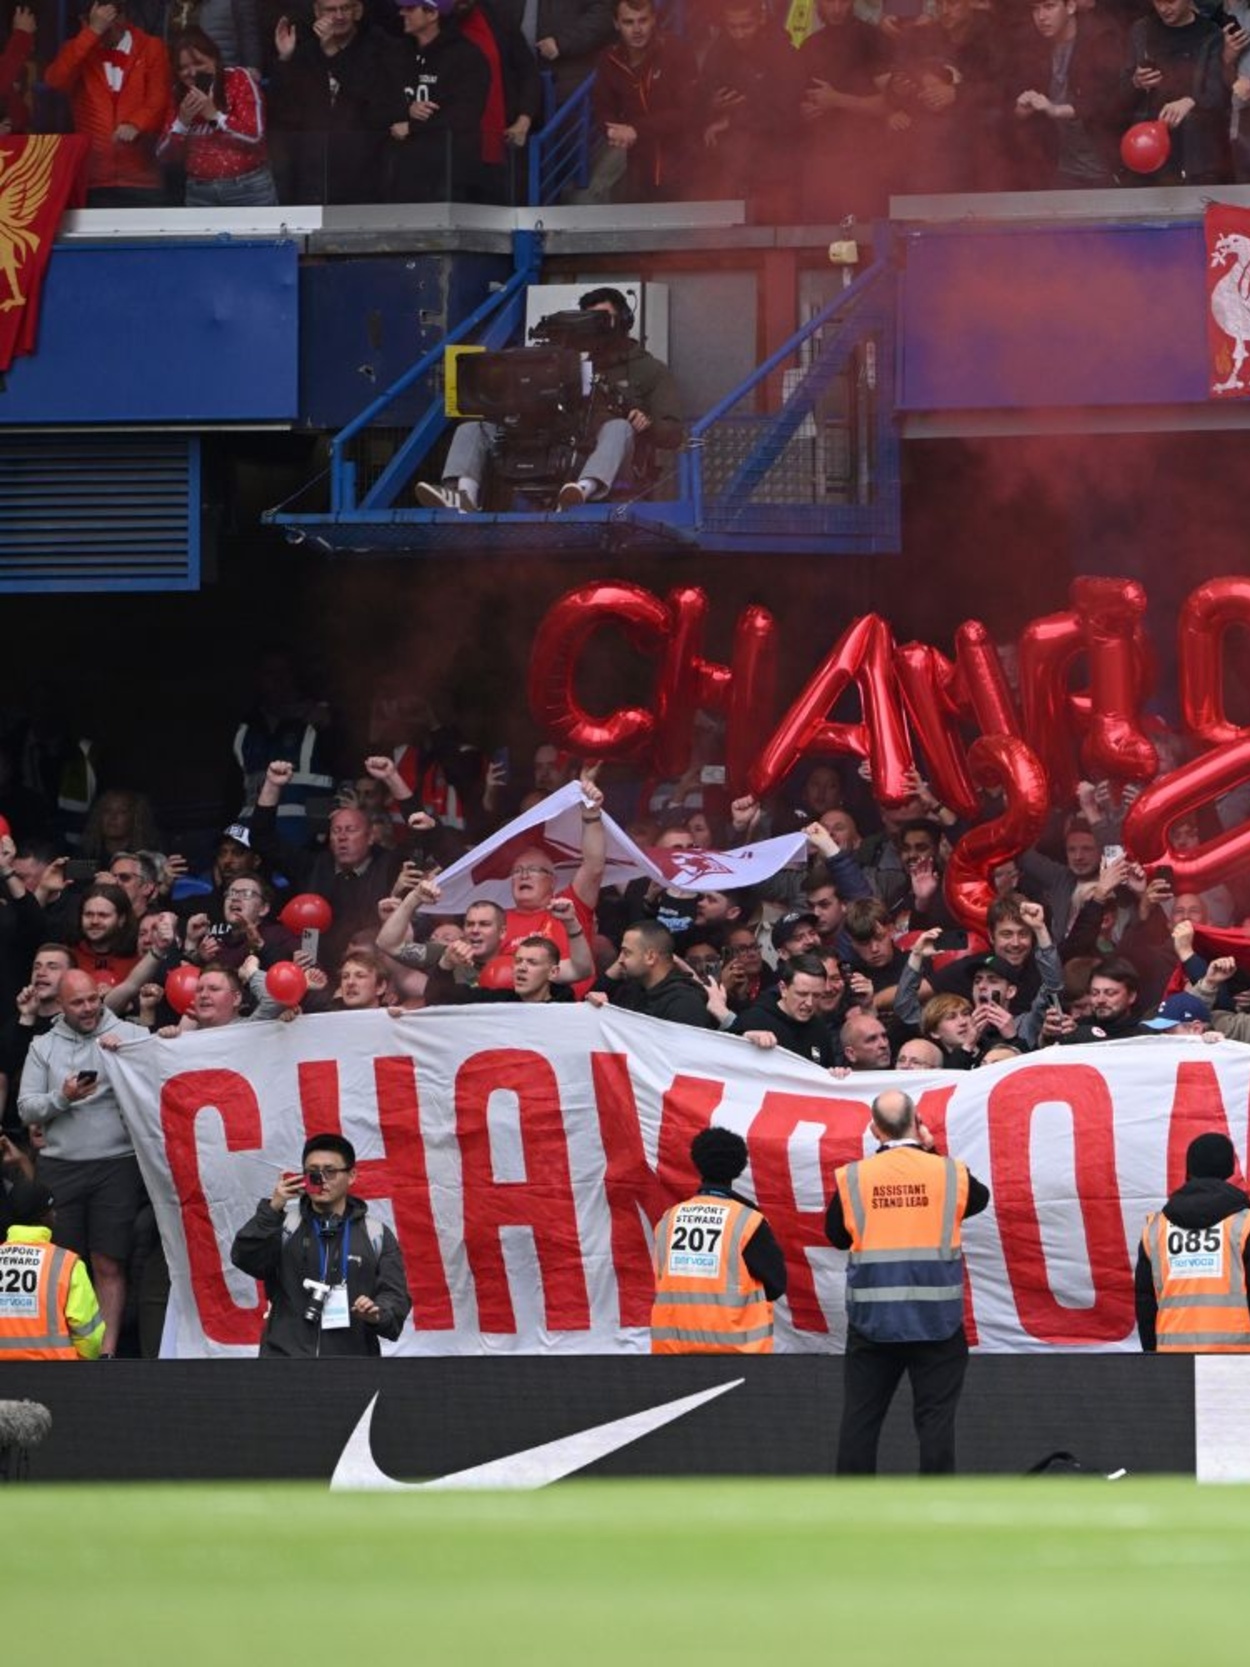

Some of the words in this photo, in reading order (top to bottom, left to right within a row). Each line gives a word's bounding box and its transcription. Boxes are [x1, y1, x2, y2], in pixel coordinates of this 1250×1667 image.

[873, 1184, 926, 1197] ASSISTANT
[872, 1198, 903, 1209] STAND
[906, 1196, 929, 1207] LEAD
[676, 1214, 724, 1225] STEWARD
[671, 1226, 722, 1253] 207
[1168, 1228, 1221, 1255] 085
[0, 1246, 41, 1256] UPPORT
[0, 1269, 37, 1293] 20
